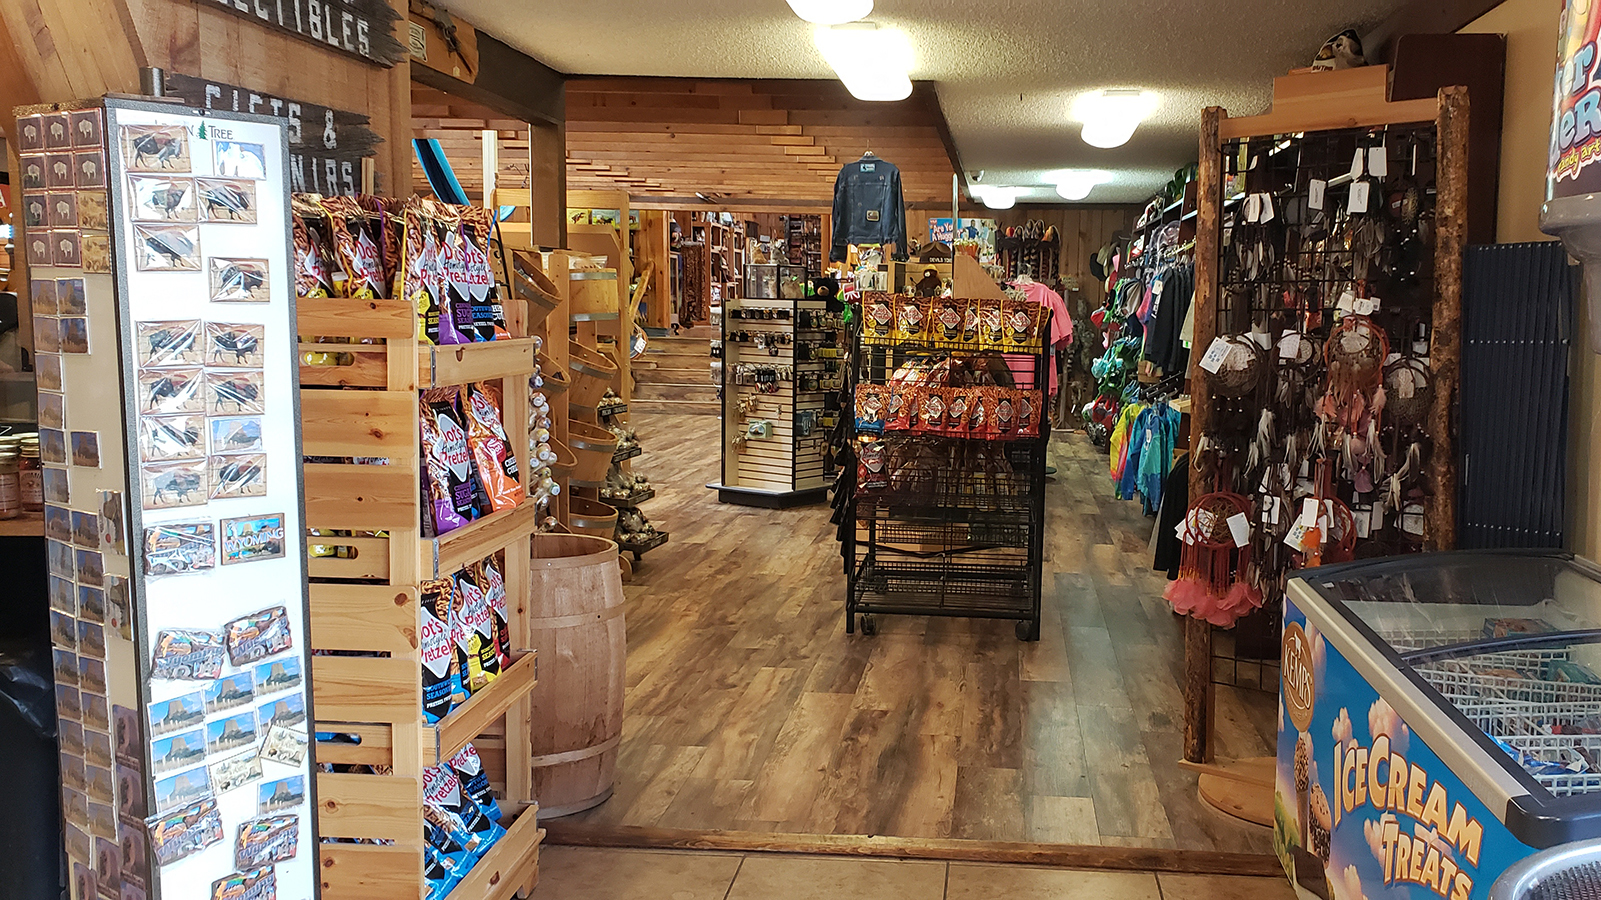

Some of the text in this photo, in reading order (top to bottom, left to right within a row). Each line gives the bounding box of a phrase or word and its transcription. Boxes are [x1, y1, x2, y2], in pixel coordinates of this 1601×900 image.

[208, 125, 234, 140] TREE
[323, 109, 337, 149] &
[944, 222, 953, 232] Yo
[466, 248, 484, 264] ot's
[443, 425, 463, 443] ot's
[440, 447, 469, 467] Pretzel
[224, 527, 284, 552] WYOMING
[466, 587, 482, 607] ot's
[421, 637, 452, 664] Pretzel
[1283, 643, 1313, 709] KEMPS
[449, 745, 478, 772] Pretze
[423, 767, 441, 790] ot's
[1382, 820, 1474, 900] TREATS
